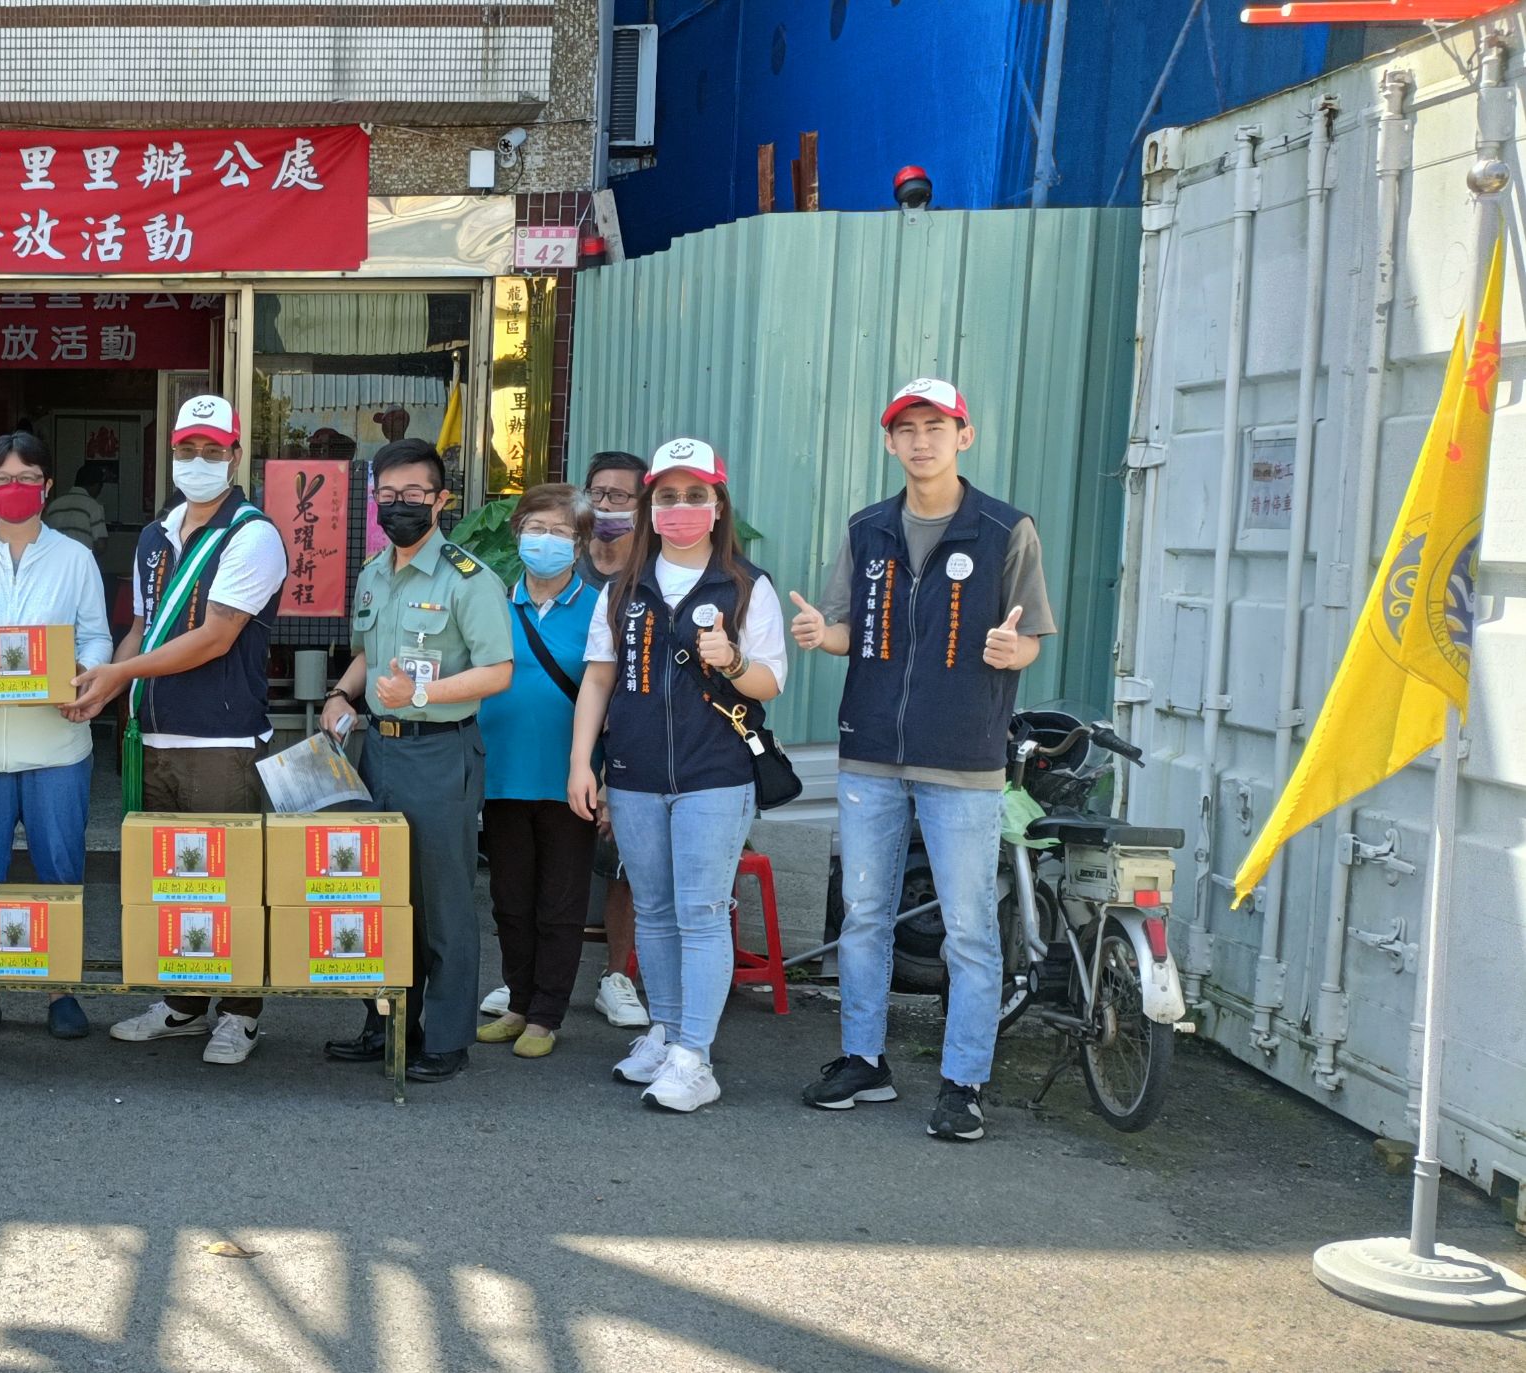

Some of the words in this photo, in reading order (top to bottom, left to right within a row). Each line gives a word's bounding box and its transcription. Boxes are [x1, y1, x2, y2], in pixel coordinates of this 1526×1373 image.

[534, 244, 565, 265] 42
[506, 285, 523, 335] 龍潭區
